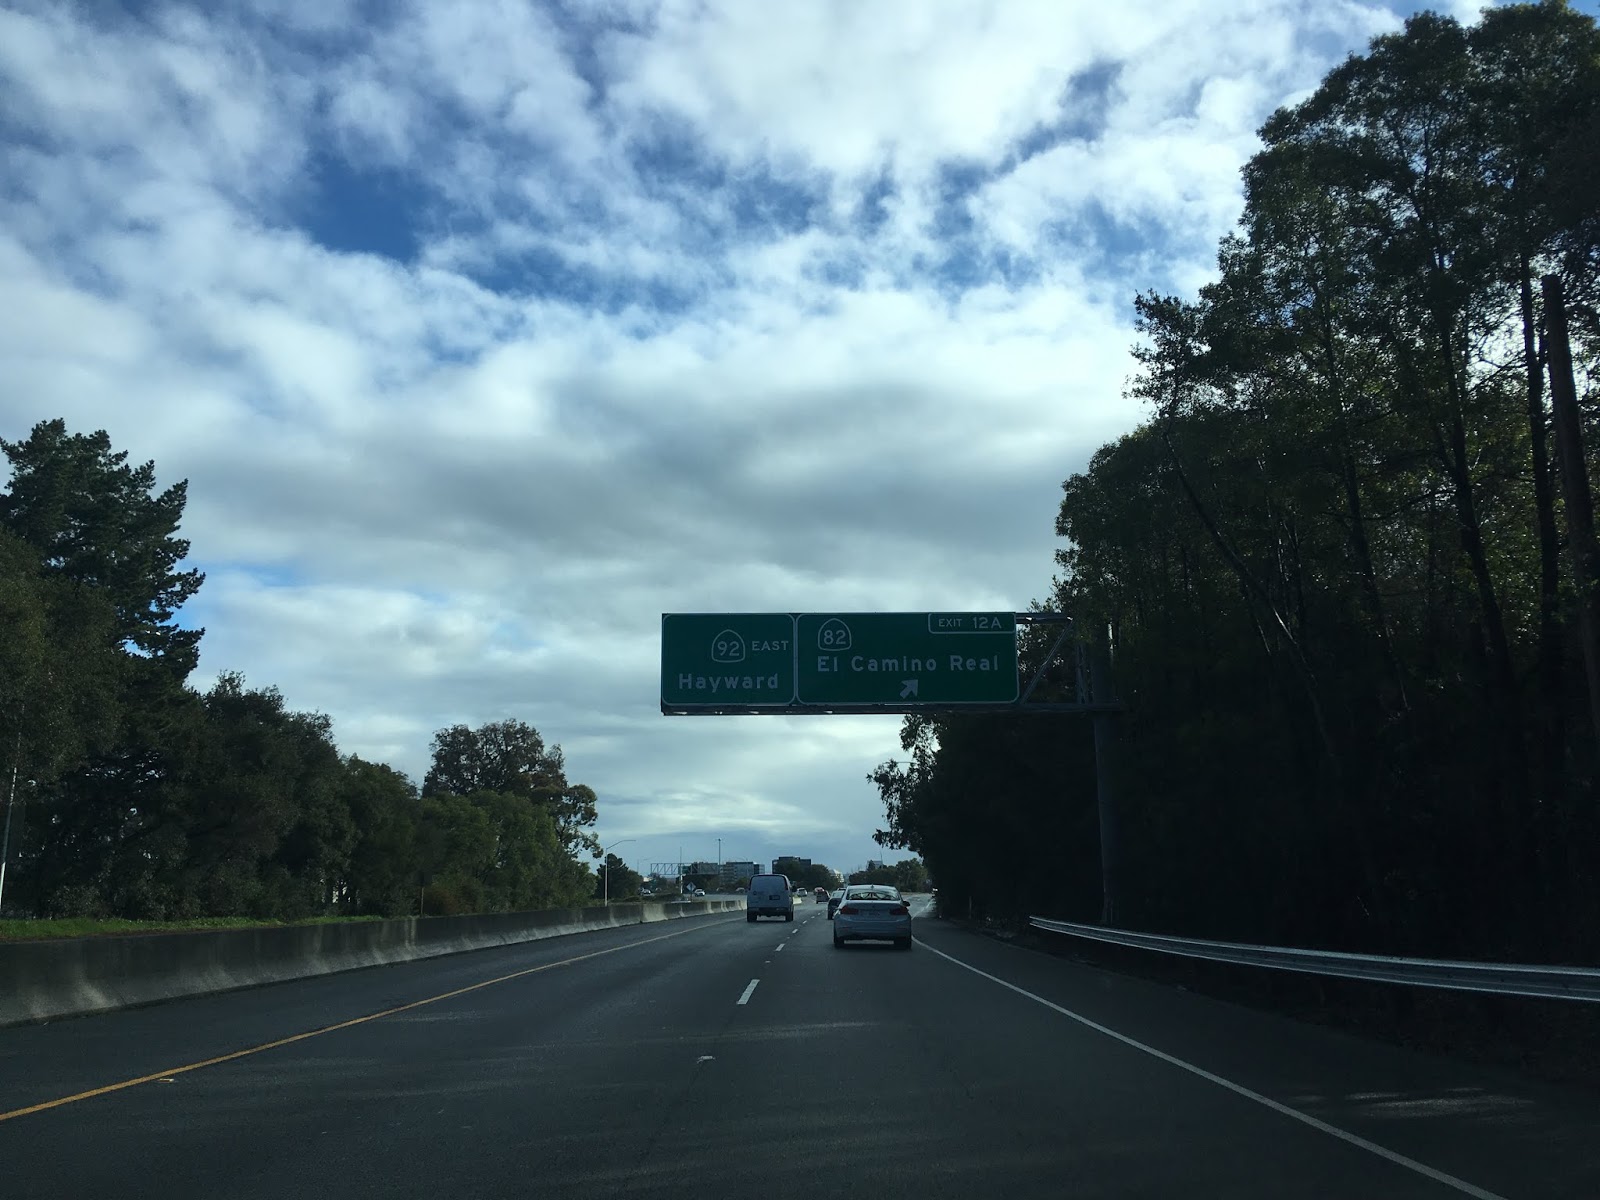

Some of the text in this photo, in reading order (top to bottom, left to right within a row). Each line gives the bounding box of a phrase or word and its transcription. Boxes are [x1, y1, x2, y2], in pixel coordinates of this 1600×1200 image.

[938, 616, 1002, 629] EXIT 12A
[823, 629, 847, 645] 82
[717, 640, 789, 656] 92 EAST
[817, 655, 999, 672] El Camino Real
[678, 673, 778, 693] Hayward
